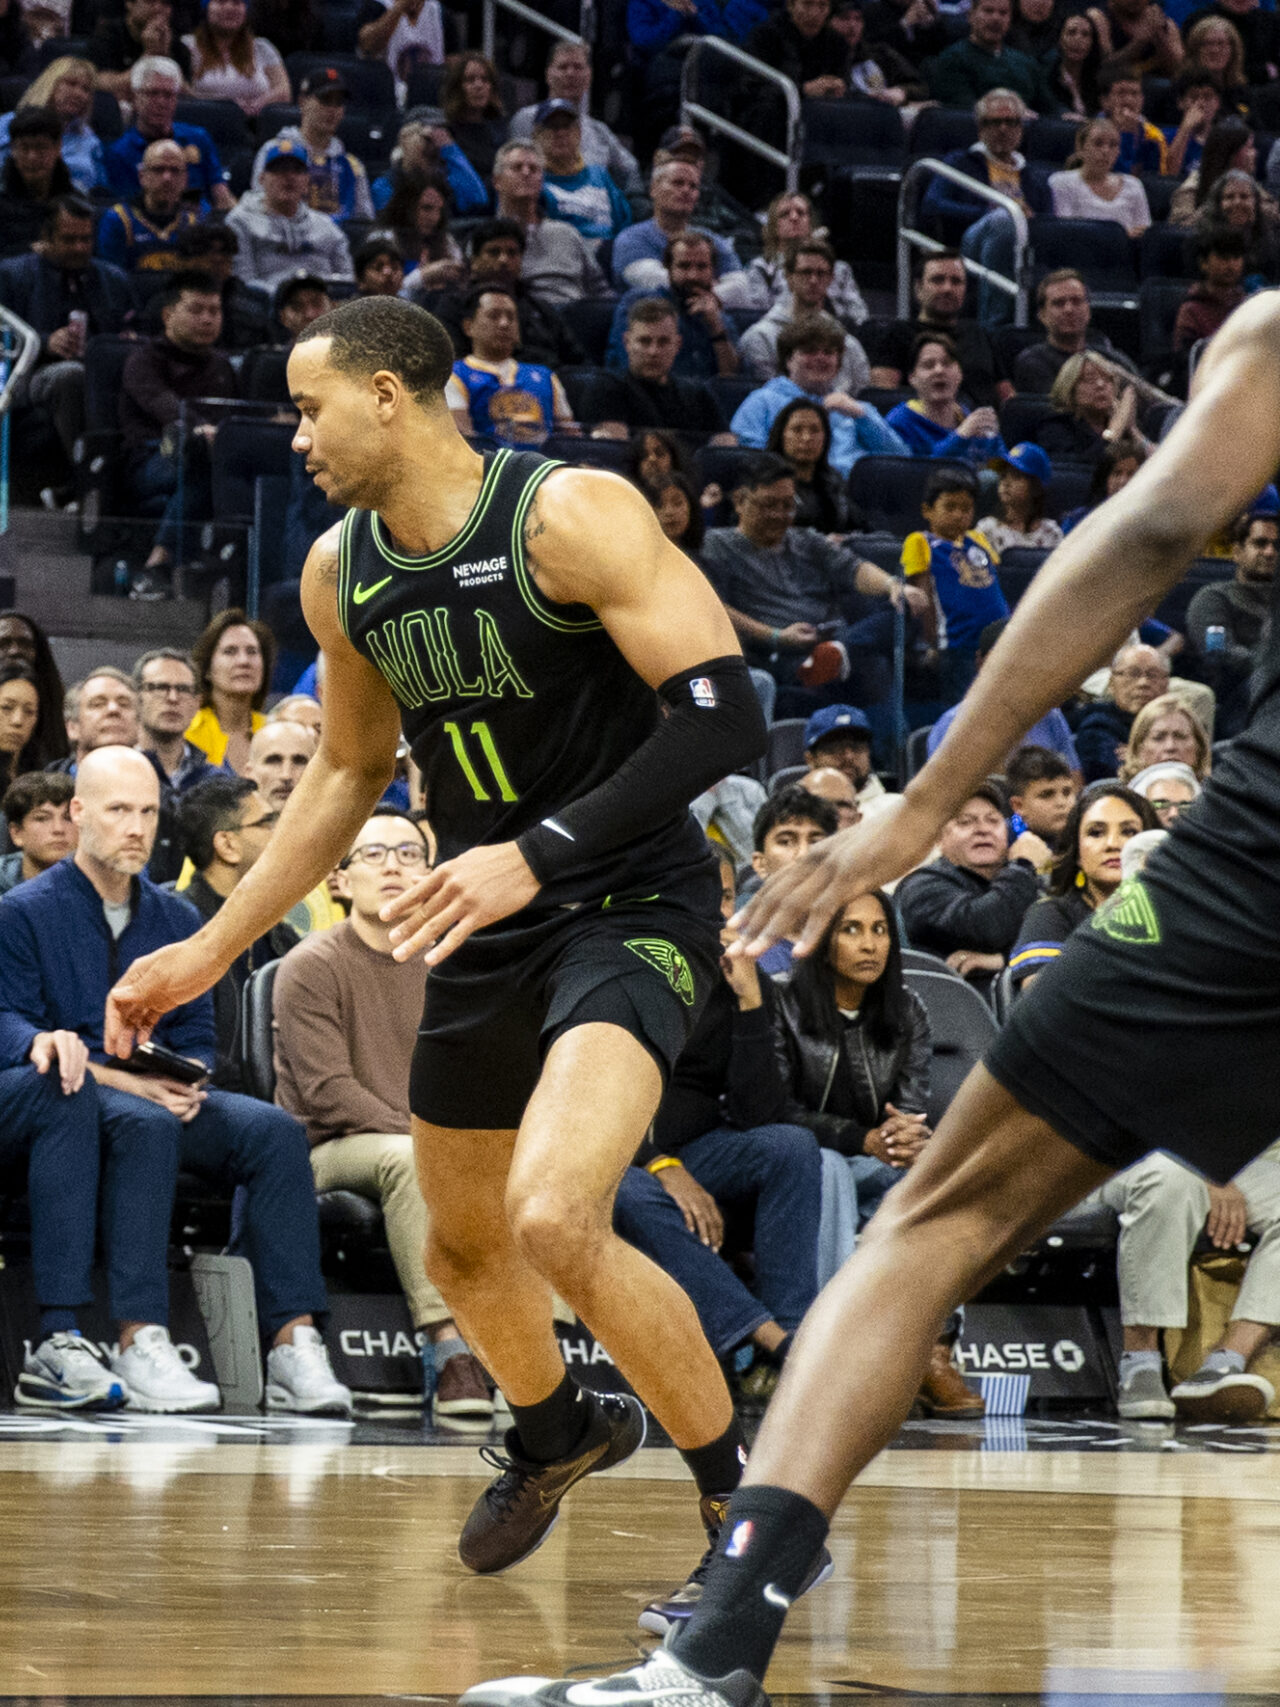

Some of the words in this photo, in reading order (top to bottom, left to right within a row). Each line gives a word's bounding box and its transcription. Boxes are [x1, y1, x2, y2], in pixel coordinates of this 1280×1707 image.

[453, 556, 508, 579] NEWAGE
[459, 572, 504, 588] PRODUCTS
[366, 607, 535, 710] NOLA
[443, 721, 519, 802] 11
[952, 1342, 1052, 1370] HASE
